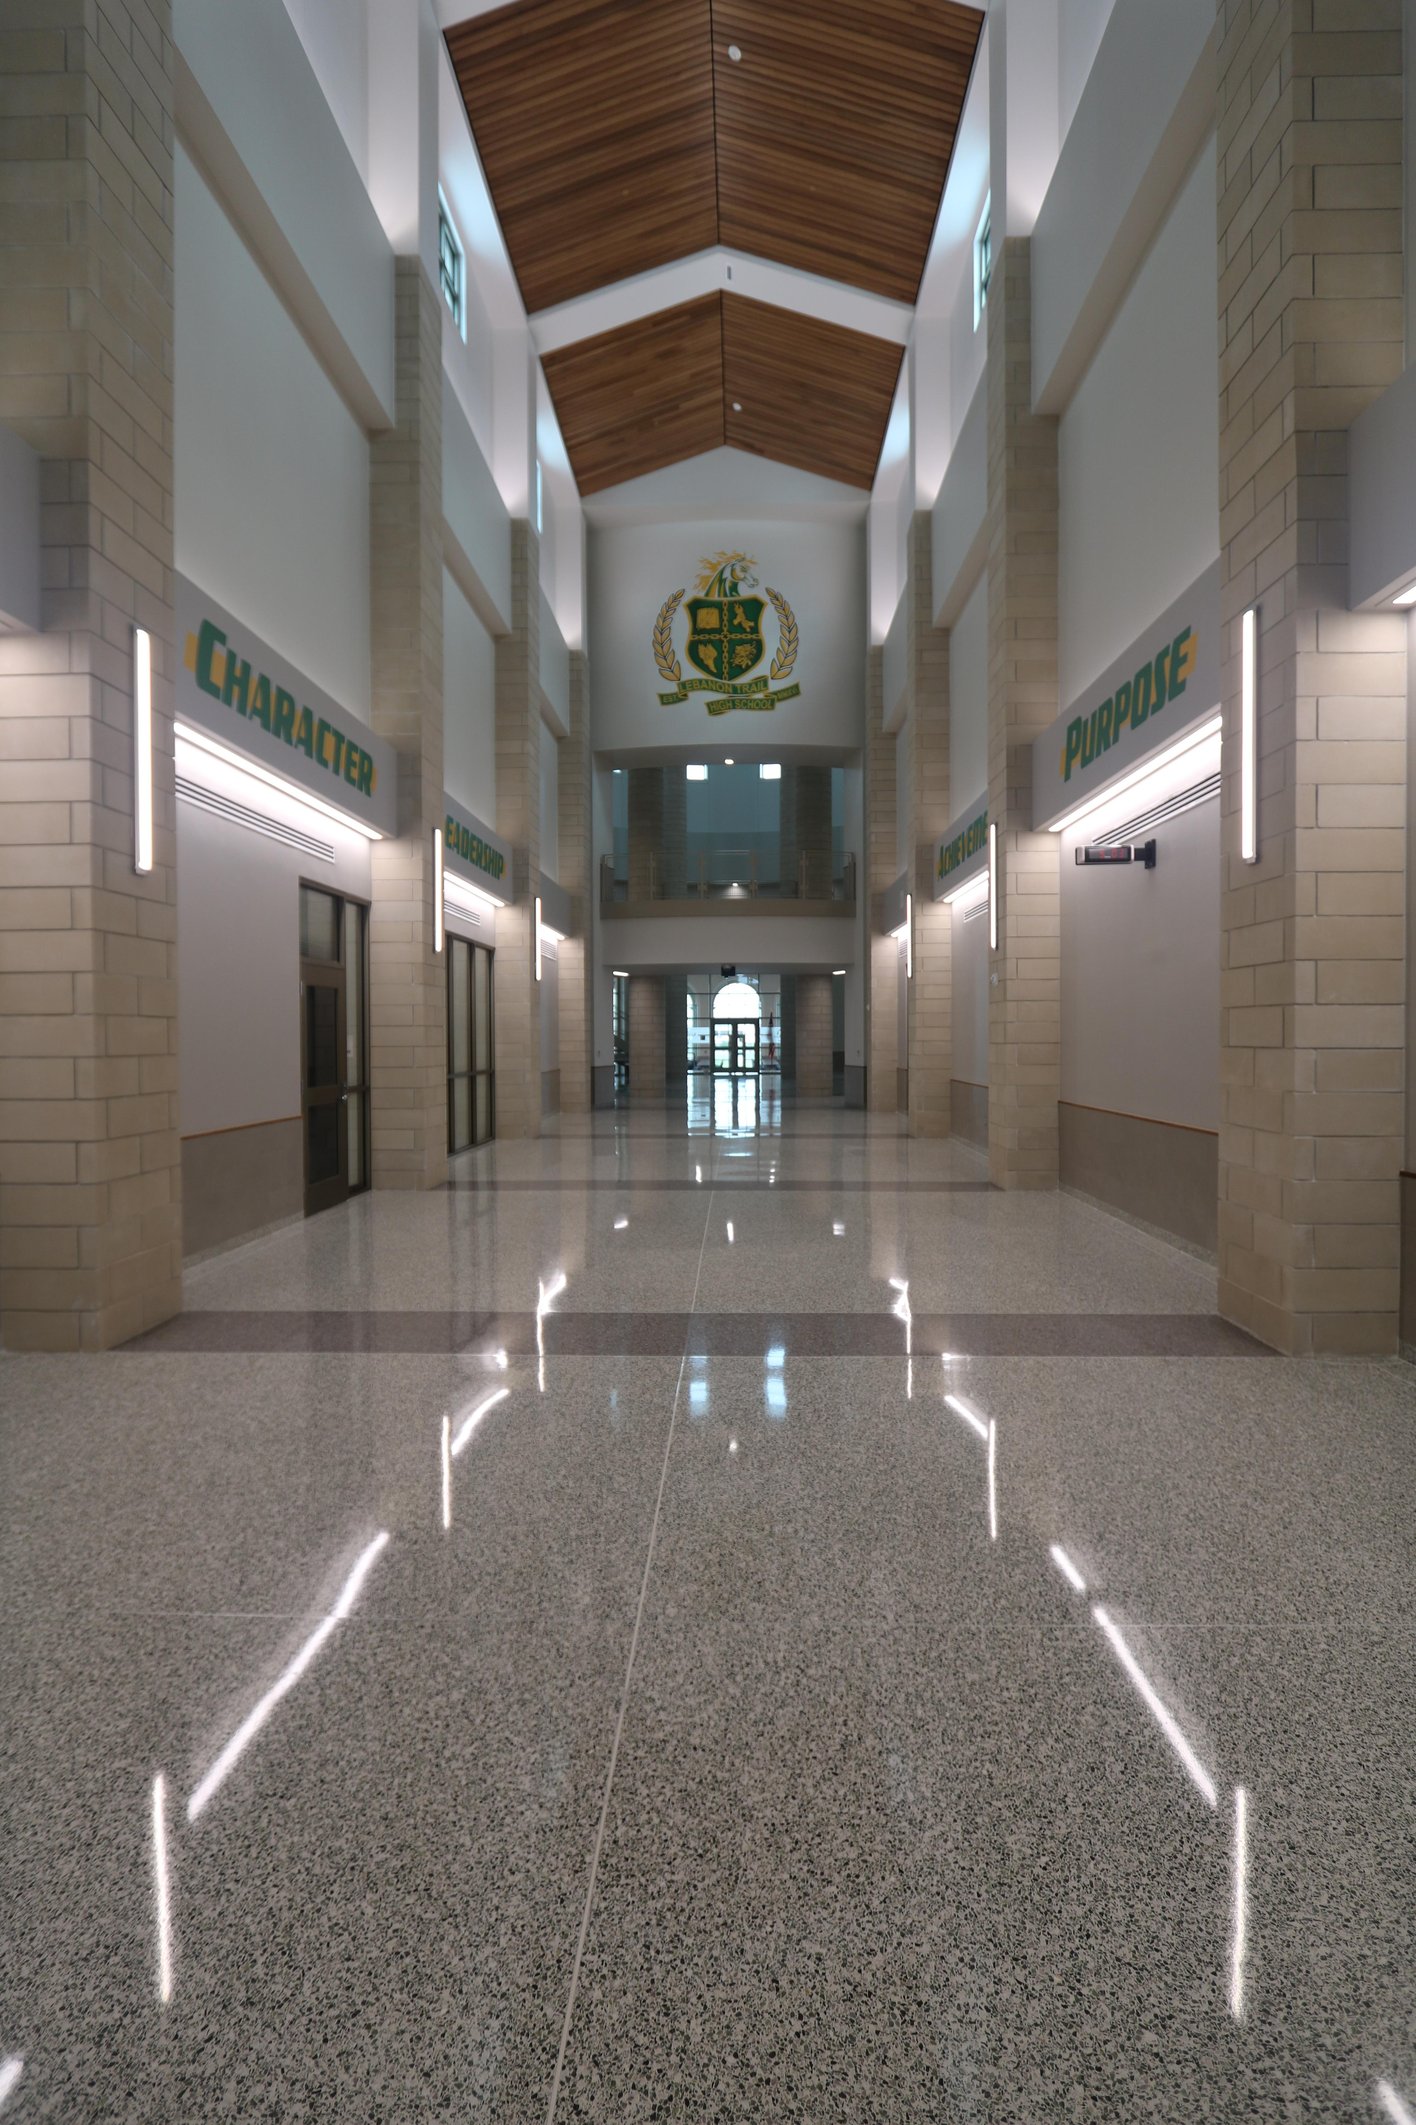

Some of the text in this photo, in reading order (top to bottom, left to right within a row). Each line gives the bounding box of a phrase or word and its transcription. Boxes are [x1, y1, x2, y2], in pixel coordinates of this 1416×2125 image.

[195, 618, 373, 798] CHARACTER
[679, 680, 768, 694] LEBANON TRAIL
[709, 699, 774, 712] HIGH SCHOOL
[1064, 624, 1192, 783] PURPOSE
[445, 814, 504, 880] EADERSHIP
[939, 810, 988, 879] ACHIEVEME
